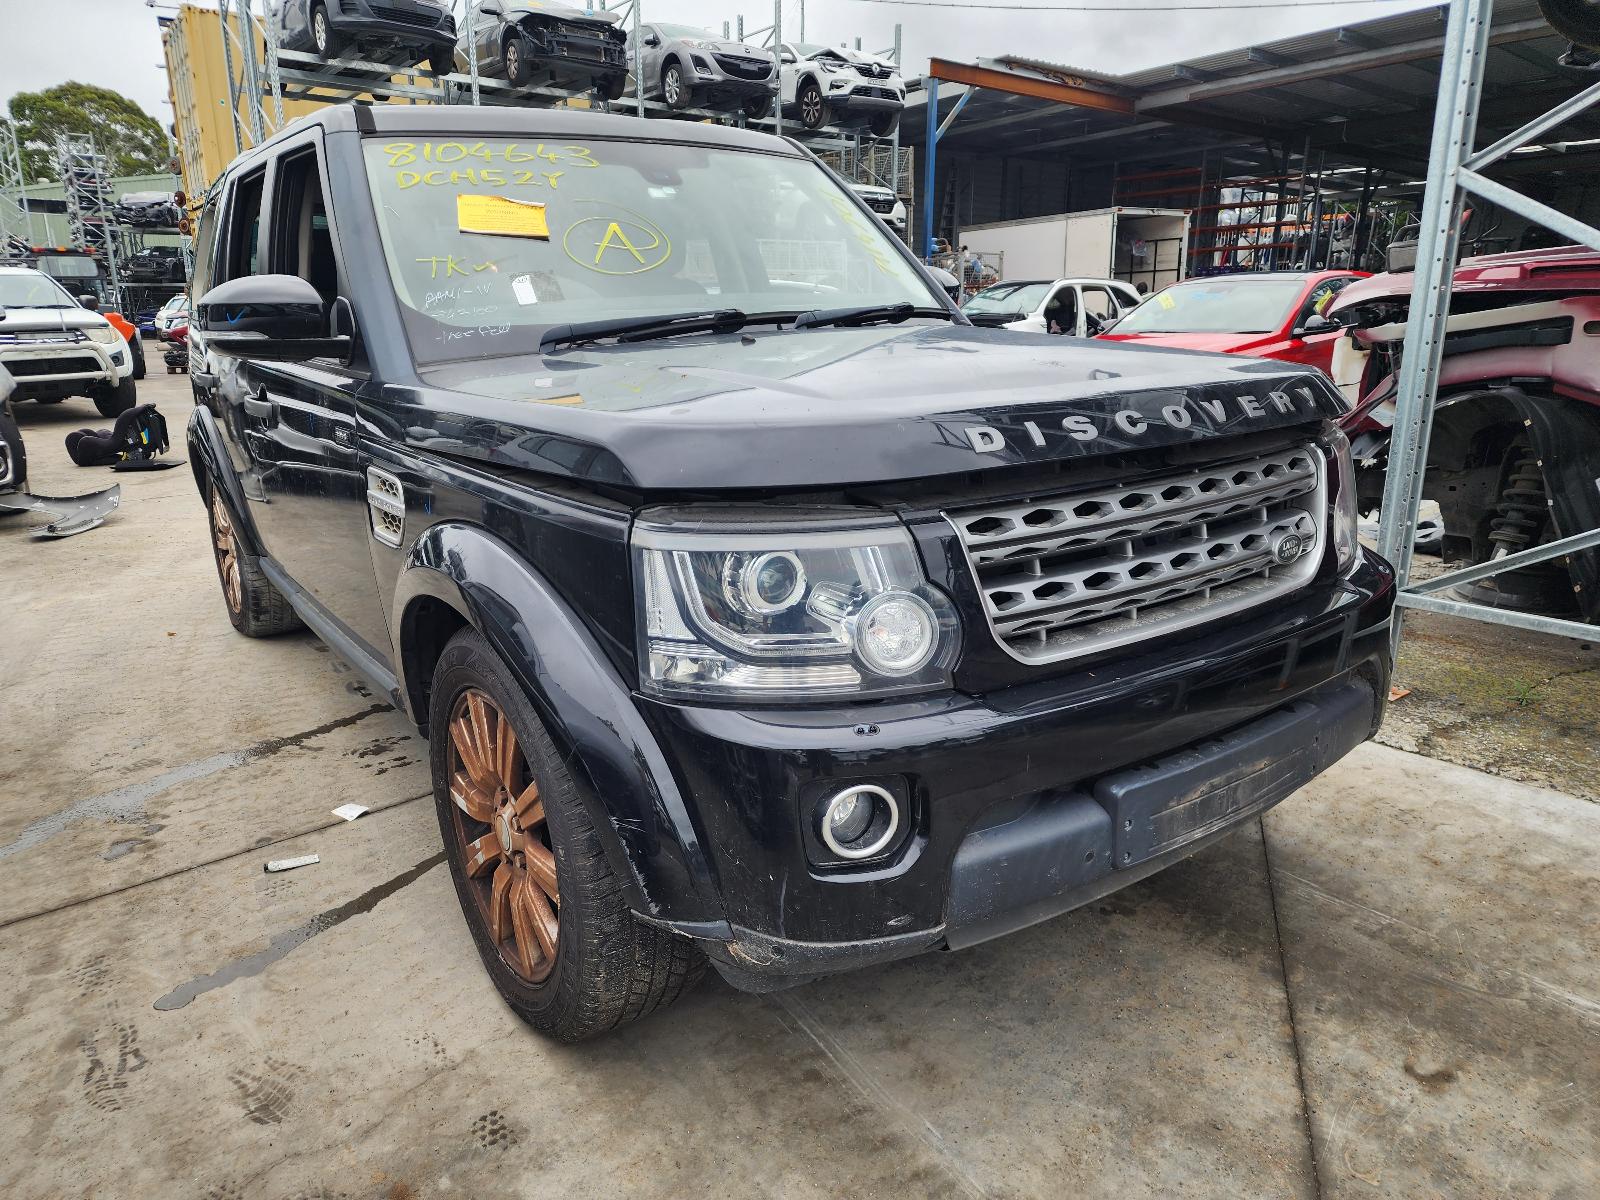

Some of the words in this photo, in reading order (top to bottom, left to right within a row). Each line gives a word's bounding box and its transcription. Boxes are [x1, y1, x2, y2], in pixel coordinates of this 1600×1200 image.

[384, 142, 599, 167] 8104643
[397, 168, 565, 189] DCH52Y
[593, 222, 645, 264] A
[964, 387, 1317, 453] DISCOVERY
